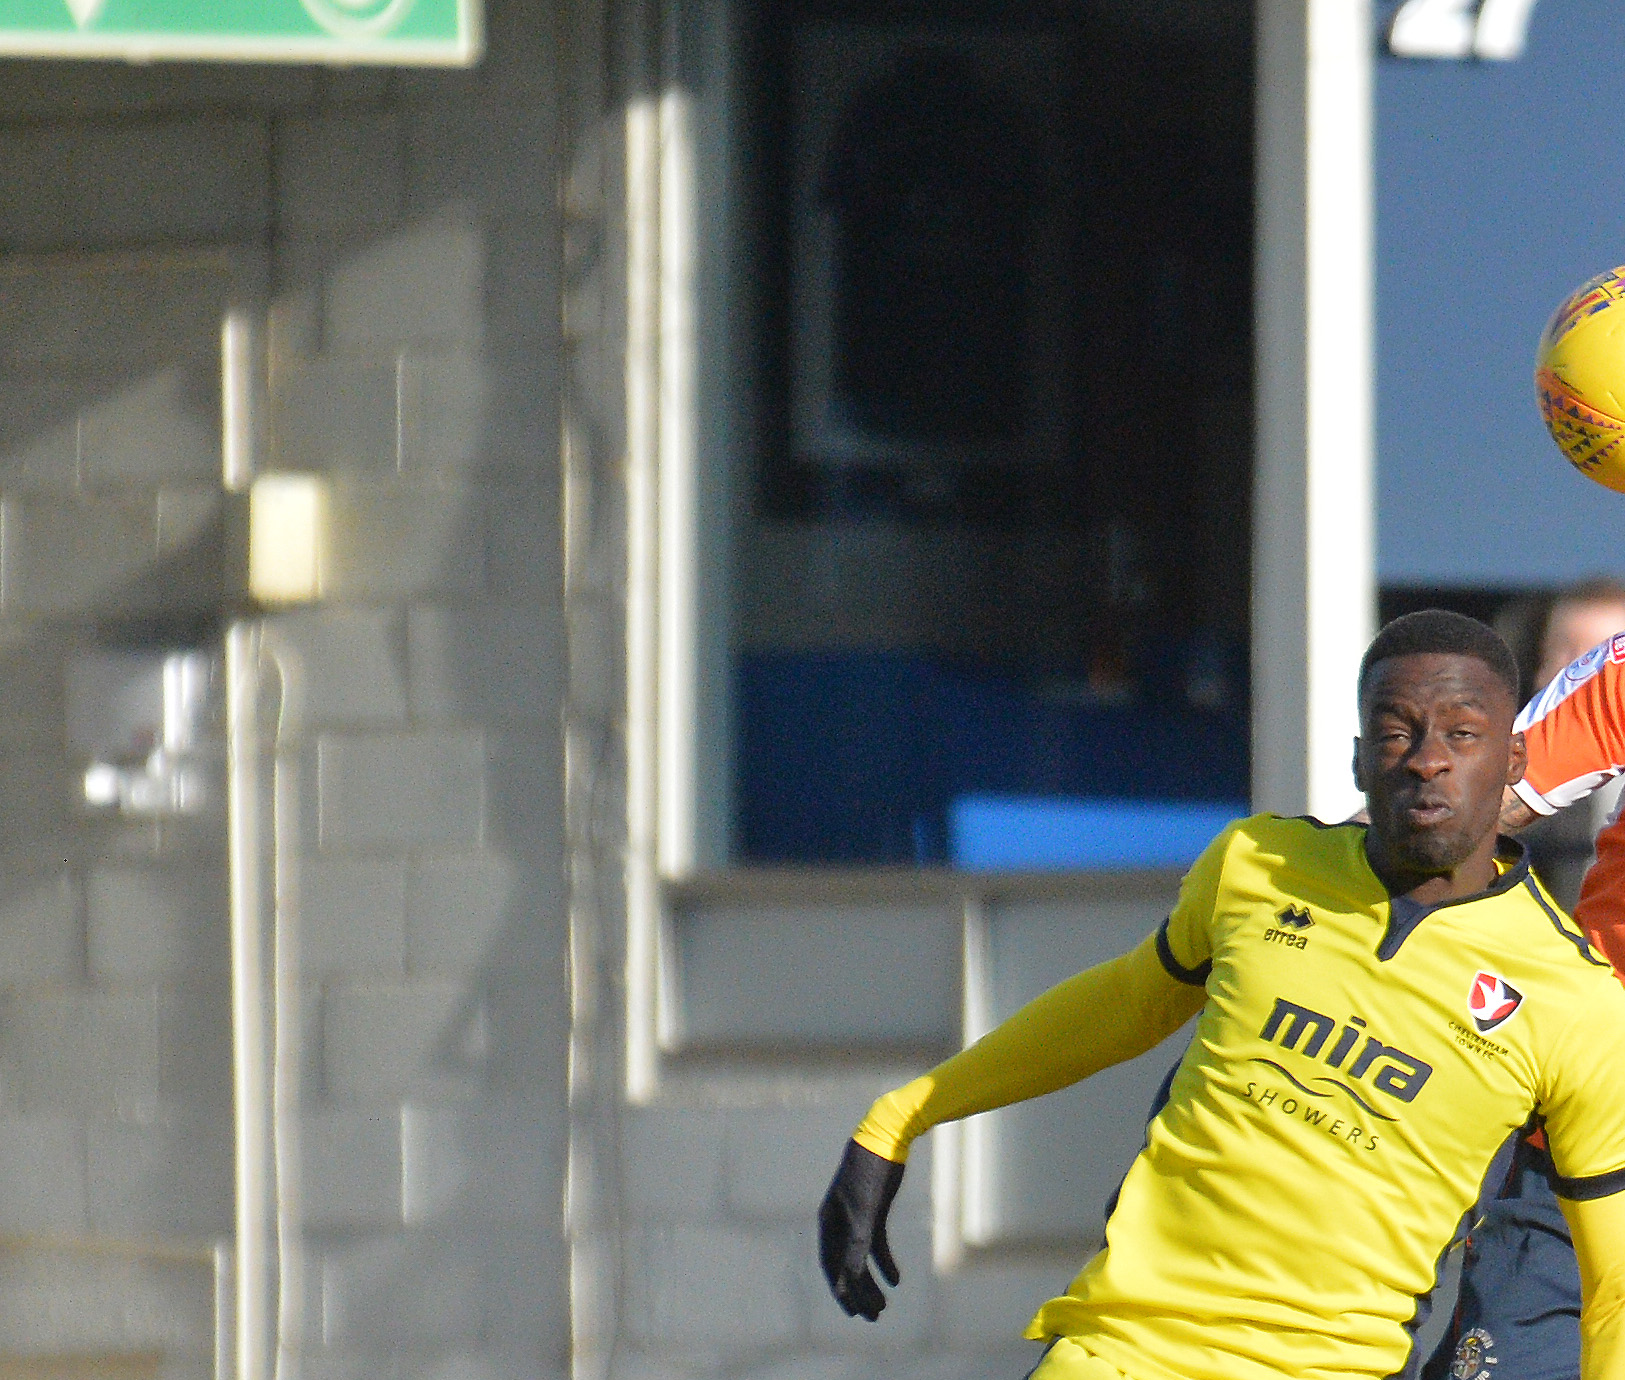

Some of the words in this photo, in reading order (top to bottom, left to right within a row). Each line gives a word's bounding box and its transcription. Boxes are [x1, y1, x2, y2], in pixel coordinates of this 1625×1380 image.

[1264, 928, 1308, 950] errea
[1260, 997, 1433, 1103] mira
[1243, 1082, 1381, 1152] SHOWERS
